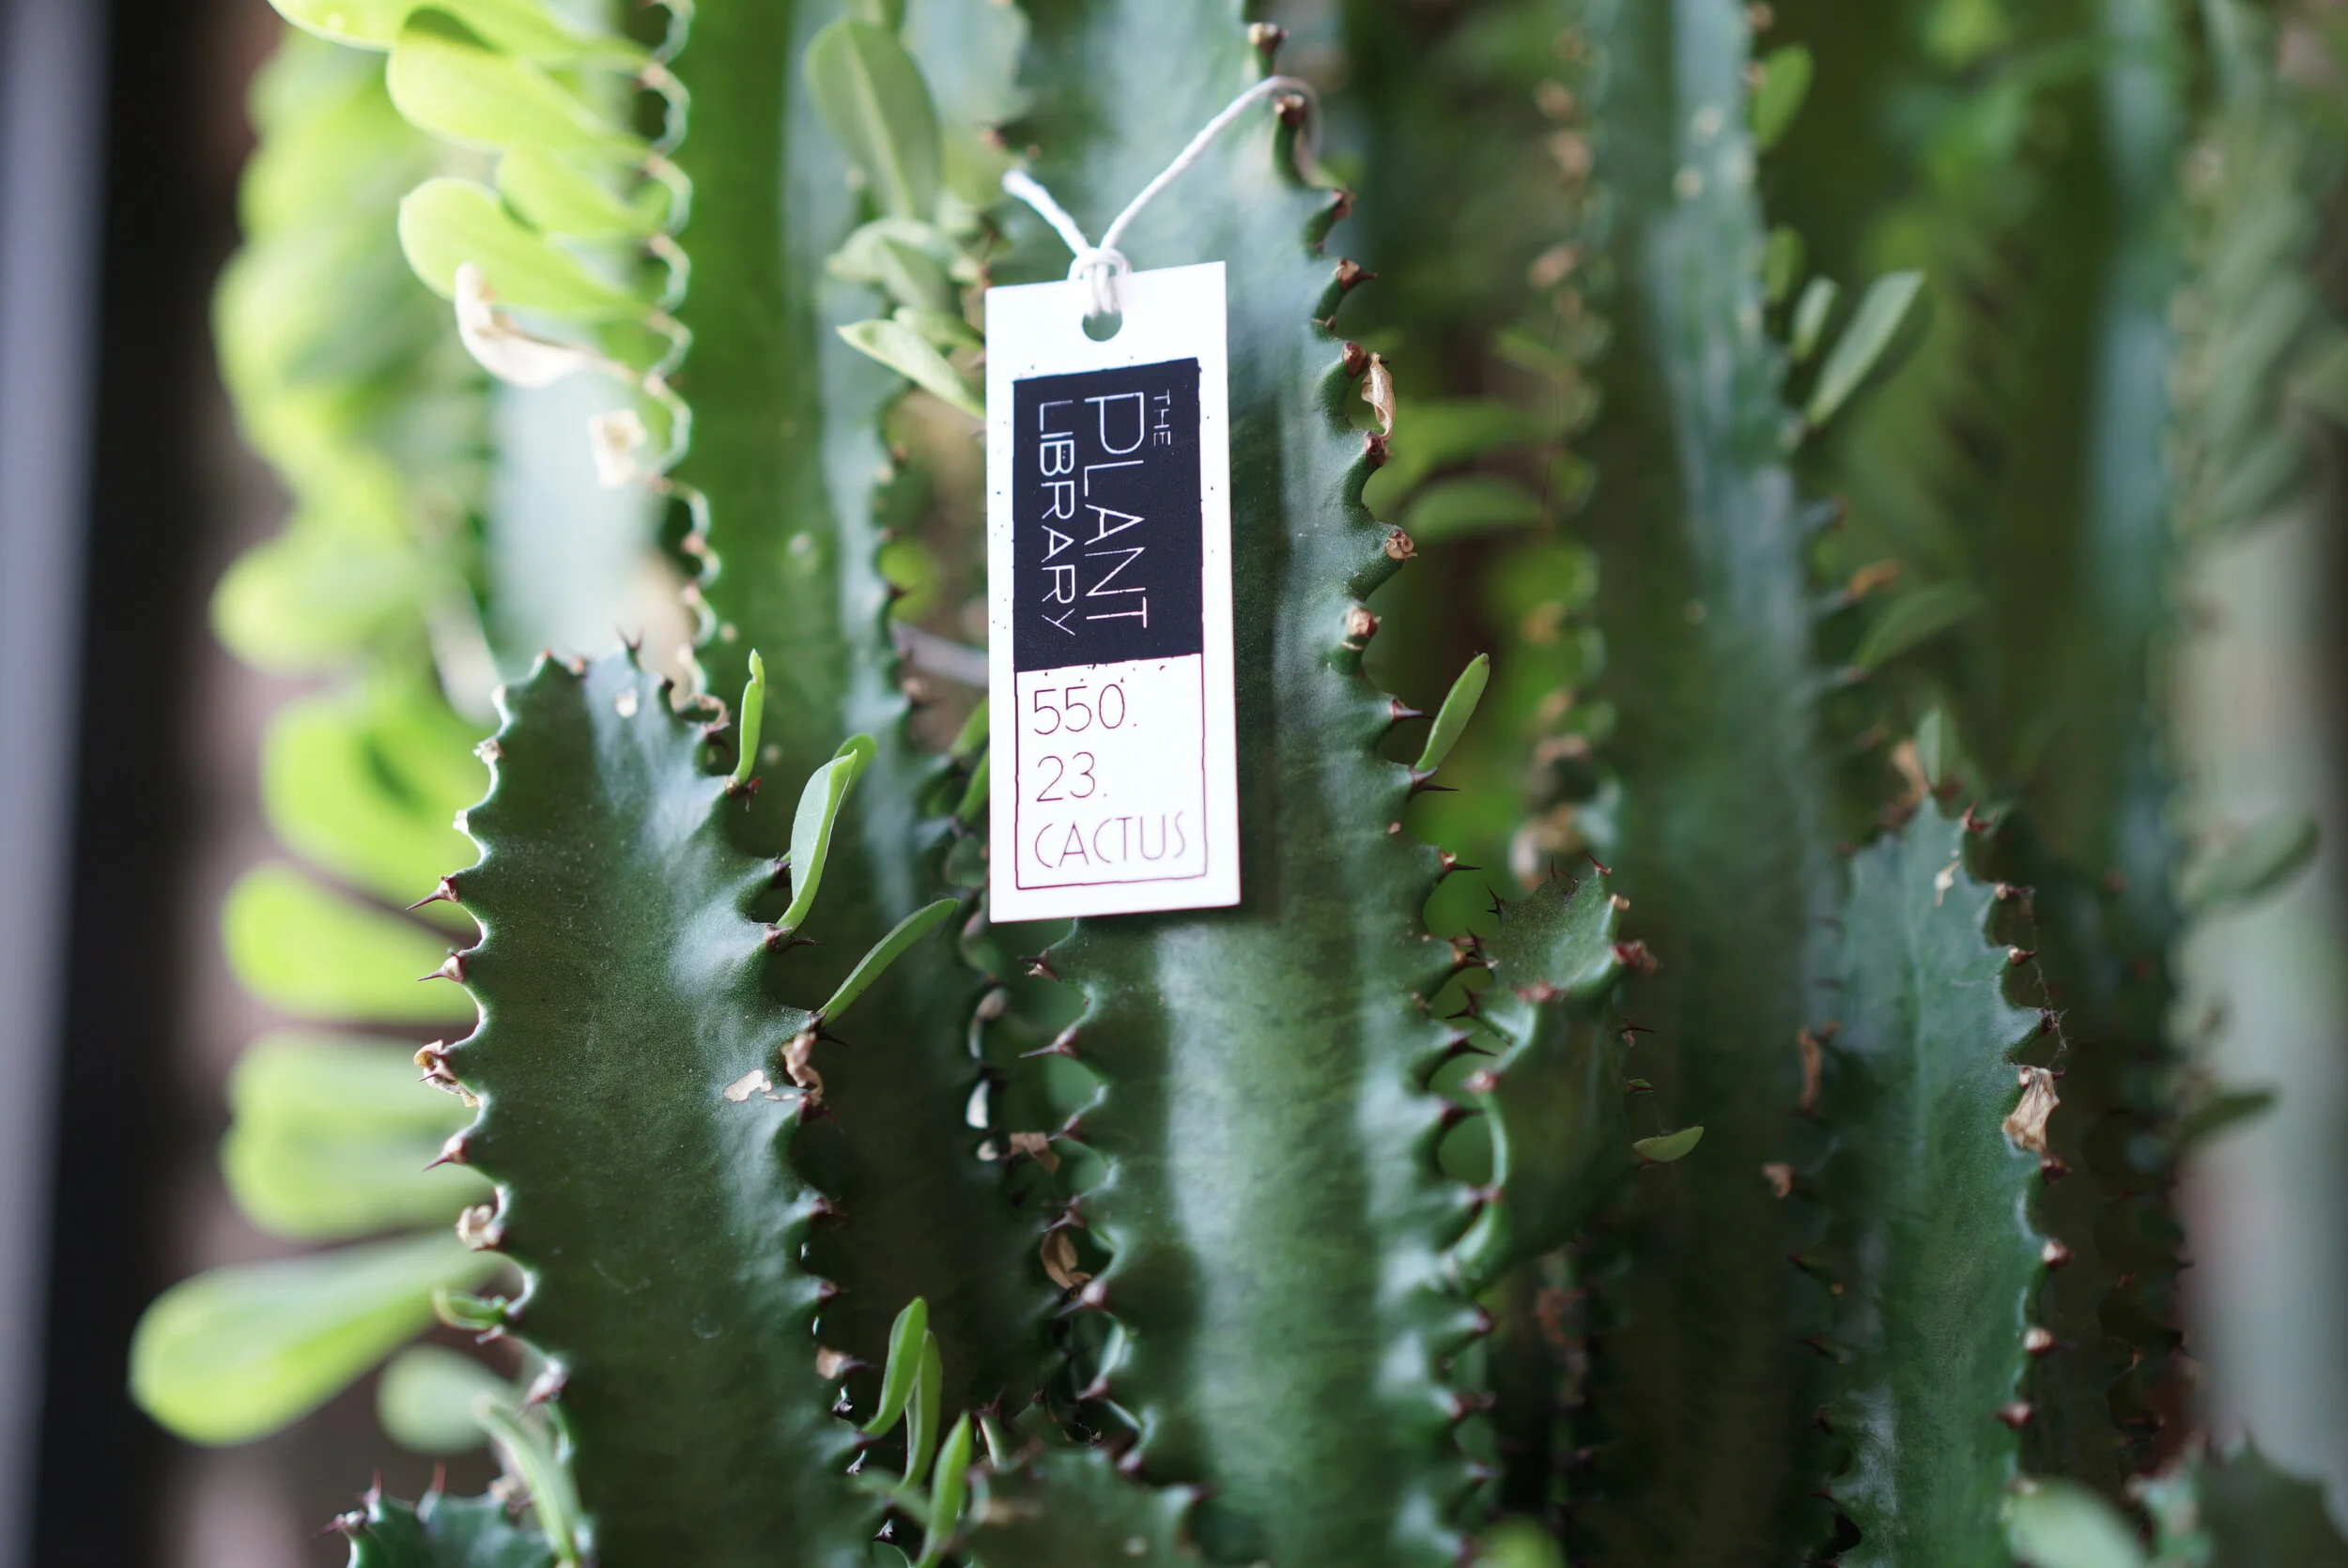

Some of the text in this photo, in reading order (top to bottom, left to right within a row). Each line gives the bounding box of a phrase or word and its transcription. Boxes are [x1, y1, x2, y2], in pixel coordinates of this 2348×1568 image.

[1153, 389, 1170, 446] THE
[1039, 400, 1075, 636] LIBRARY
[1084, 392, 1148, 628] PLANT
[1034, 684, 1137, 735] 550.
[1034, 811, 1186, 869] CACTUS
